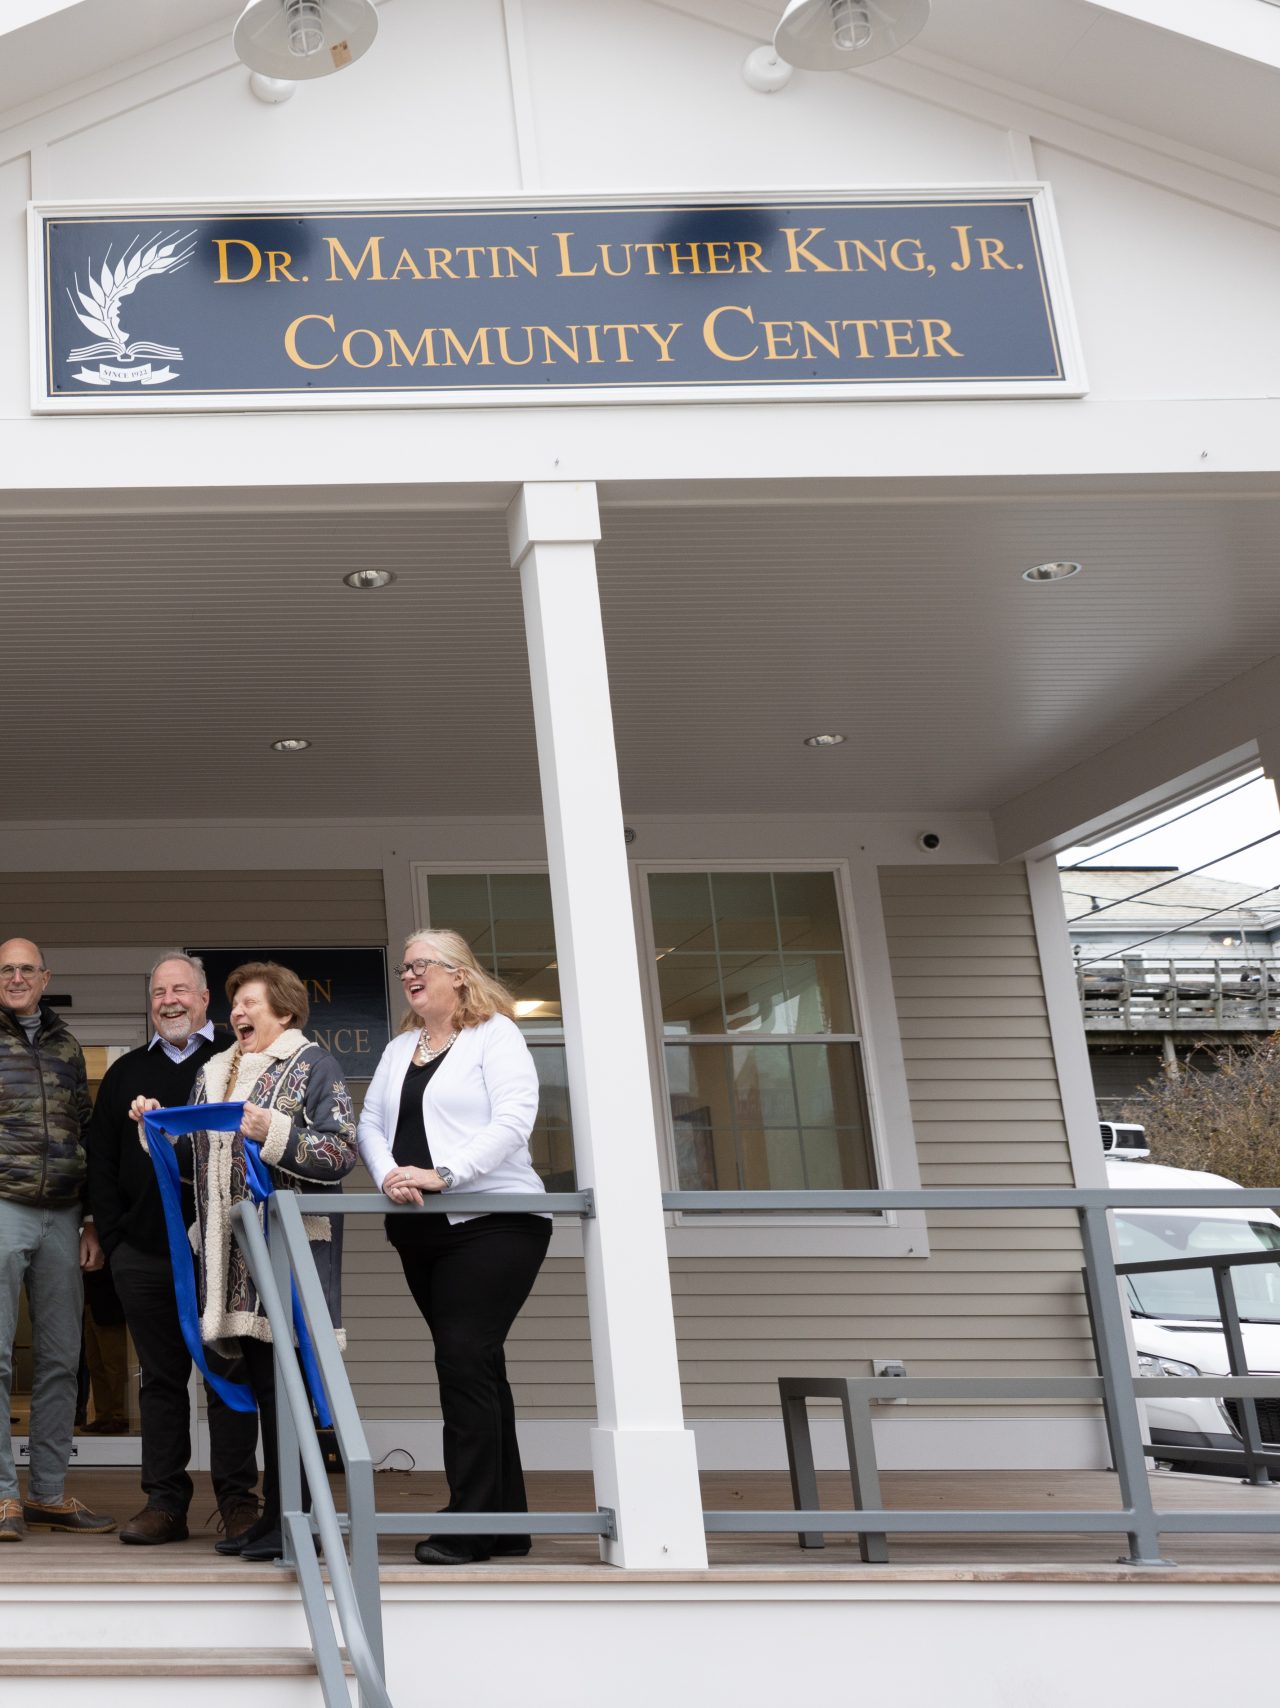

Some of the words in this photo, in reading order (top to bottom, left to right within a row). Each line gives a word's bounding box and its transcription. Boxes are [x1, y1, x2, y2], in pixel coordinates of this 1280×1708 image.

[211, 237, 309, 285] DR.
[322, 235, 539, 283] MARTIN
[552, 231, 771, 278] LUTHER
[780, 227, 937, 279] KING,
[950, 225, 1025, 272] JR.
[283, 313, 684, 370] COMMUNITY
[703, 304, 964, 362] CENTER
[103, 369, 129, 379] SINCE
